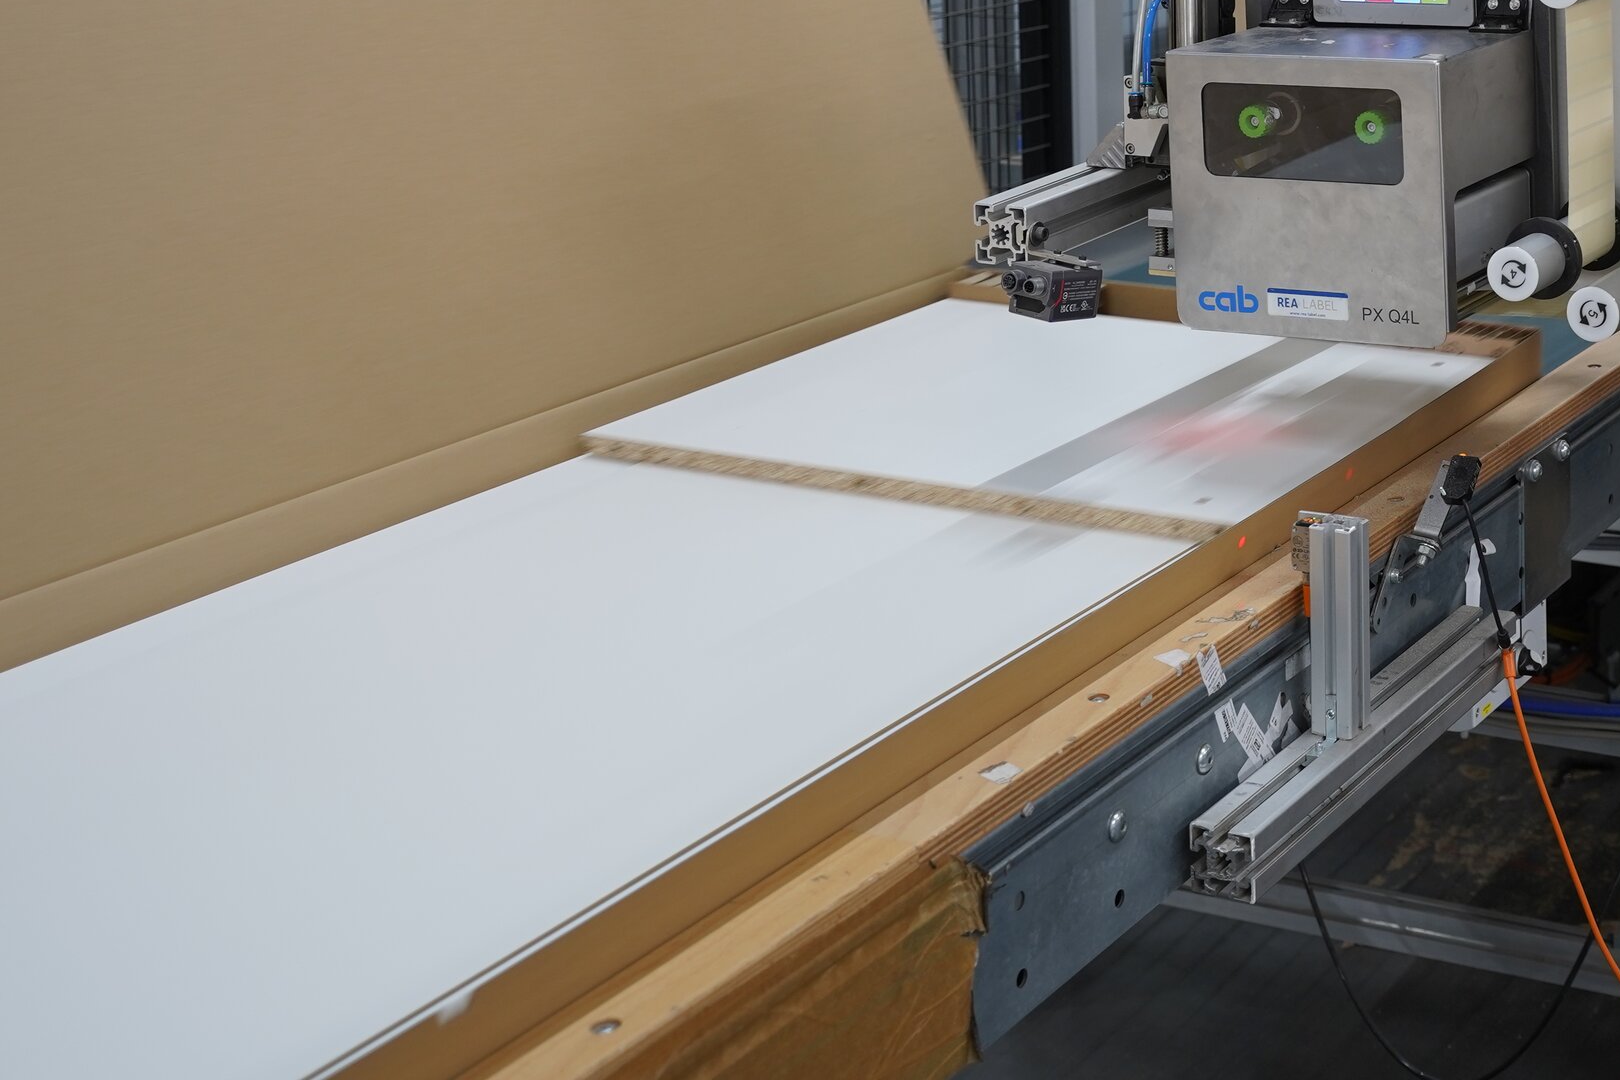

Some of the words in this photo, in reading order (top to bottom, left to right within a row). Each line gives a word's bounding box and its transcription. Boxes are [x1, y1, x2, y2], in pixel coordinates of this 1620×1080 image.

[1510, 269, 1517, 279] 4
[1198, 285, 1259, 314] cab
[1277, 297, 1298, 309] REA
[1303, 298, 1338, 312] LABEL
[1362, 307, 1384, 322] PX
[1388, 309, 1420, 325] Q4L
[1588, 310, 1598, 318] 5
